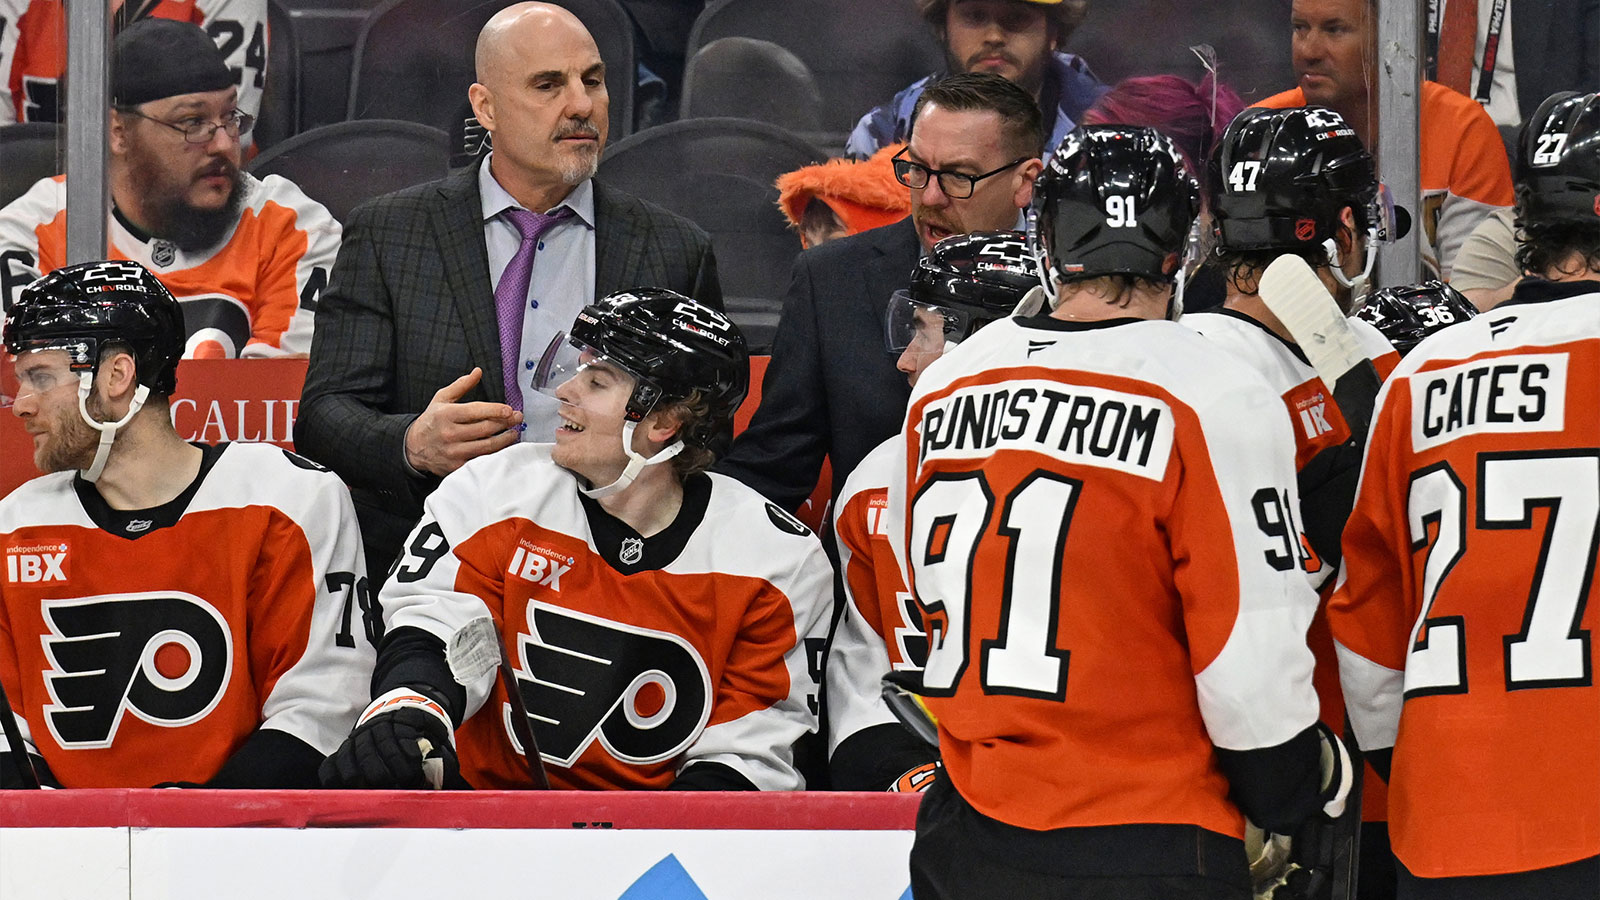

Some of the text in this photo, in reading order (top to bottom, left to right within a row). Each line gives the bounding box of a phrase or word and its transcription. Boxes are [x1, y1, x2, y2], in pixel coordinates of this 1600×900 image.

[1533, 133, 1568, 164] 27
[1229, 161, 1261, 192] 47
[1105, 195, 1138, 228] 91
[86, 284, 148, 294] CHEVROLET
[1417, 305, 1456, 328] 36
[672, 318, 730, 347] CHEVROLET
[1422, 363, 1550, 439] CATES
[7, 545, 57, 554] Independence
[519, 538, 568, 562] Independence
[7, 553, 67, 583] IBX
[507, 546, 571, 593] IBX
[1403, 448, 1600, 701] 27
[910, 467, 1084, 702] 91
